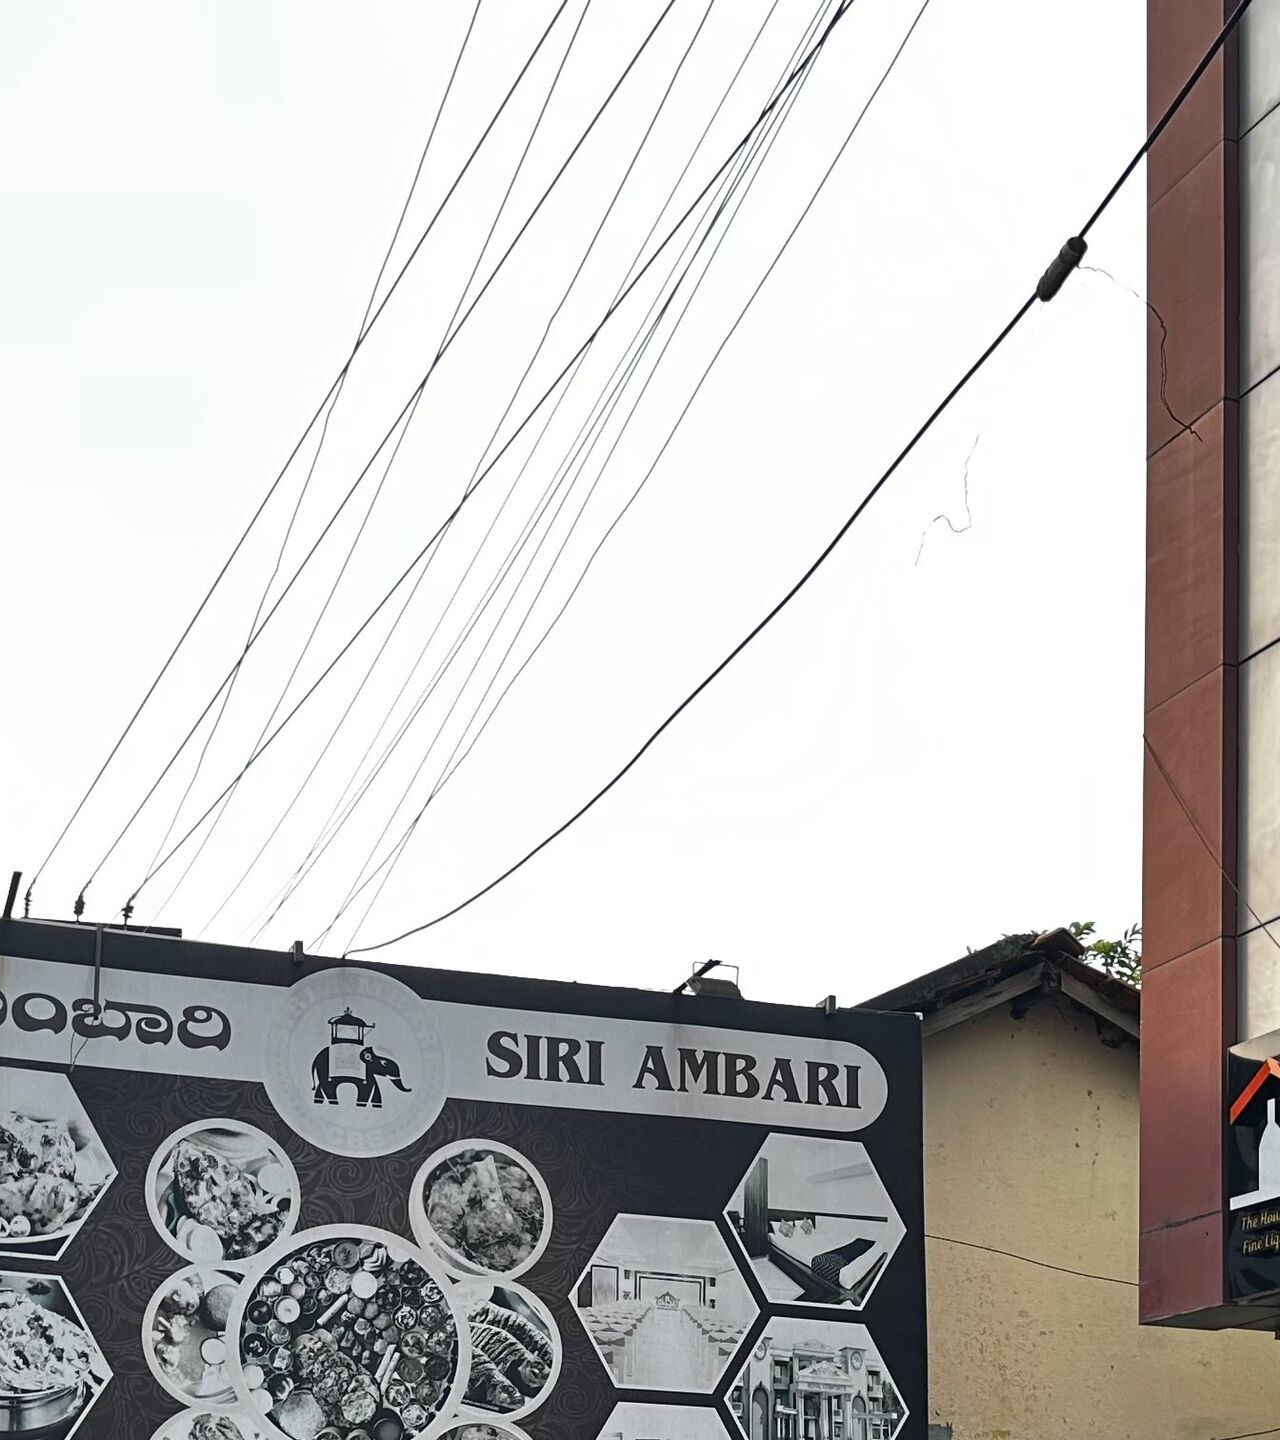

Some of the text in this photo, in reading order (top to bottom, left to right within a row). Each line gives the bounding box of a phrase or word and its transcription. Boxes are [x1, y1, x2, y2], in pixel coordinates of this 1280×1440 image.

[485, 1030, 863, 1109] SIRI AMBARI
[1241, 1215, 1259, 1231] The
[1242, 1239, 1263, 1255] Fine
